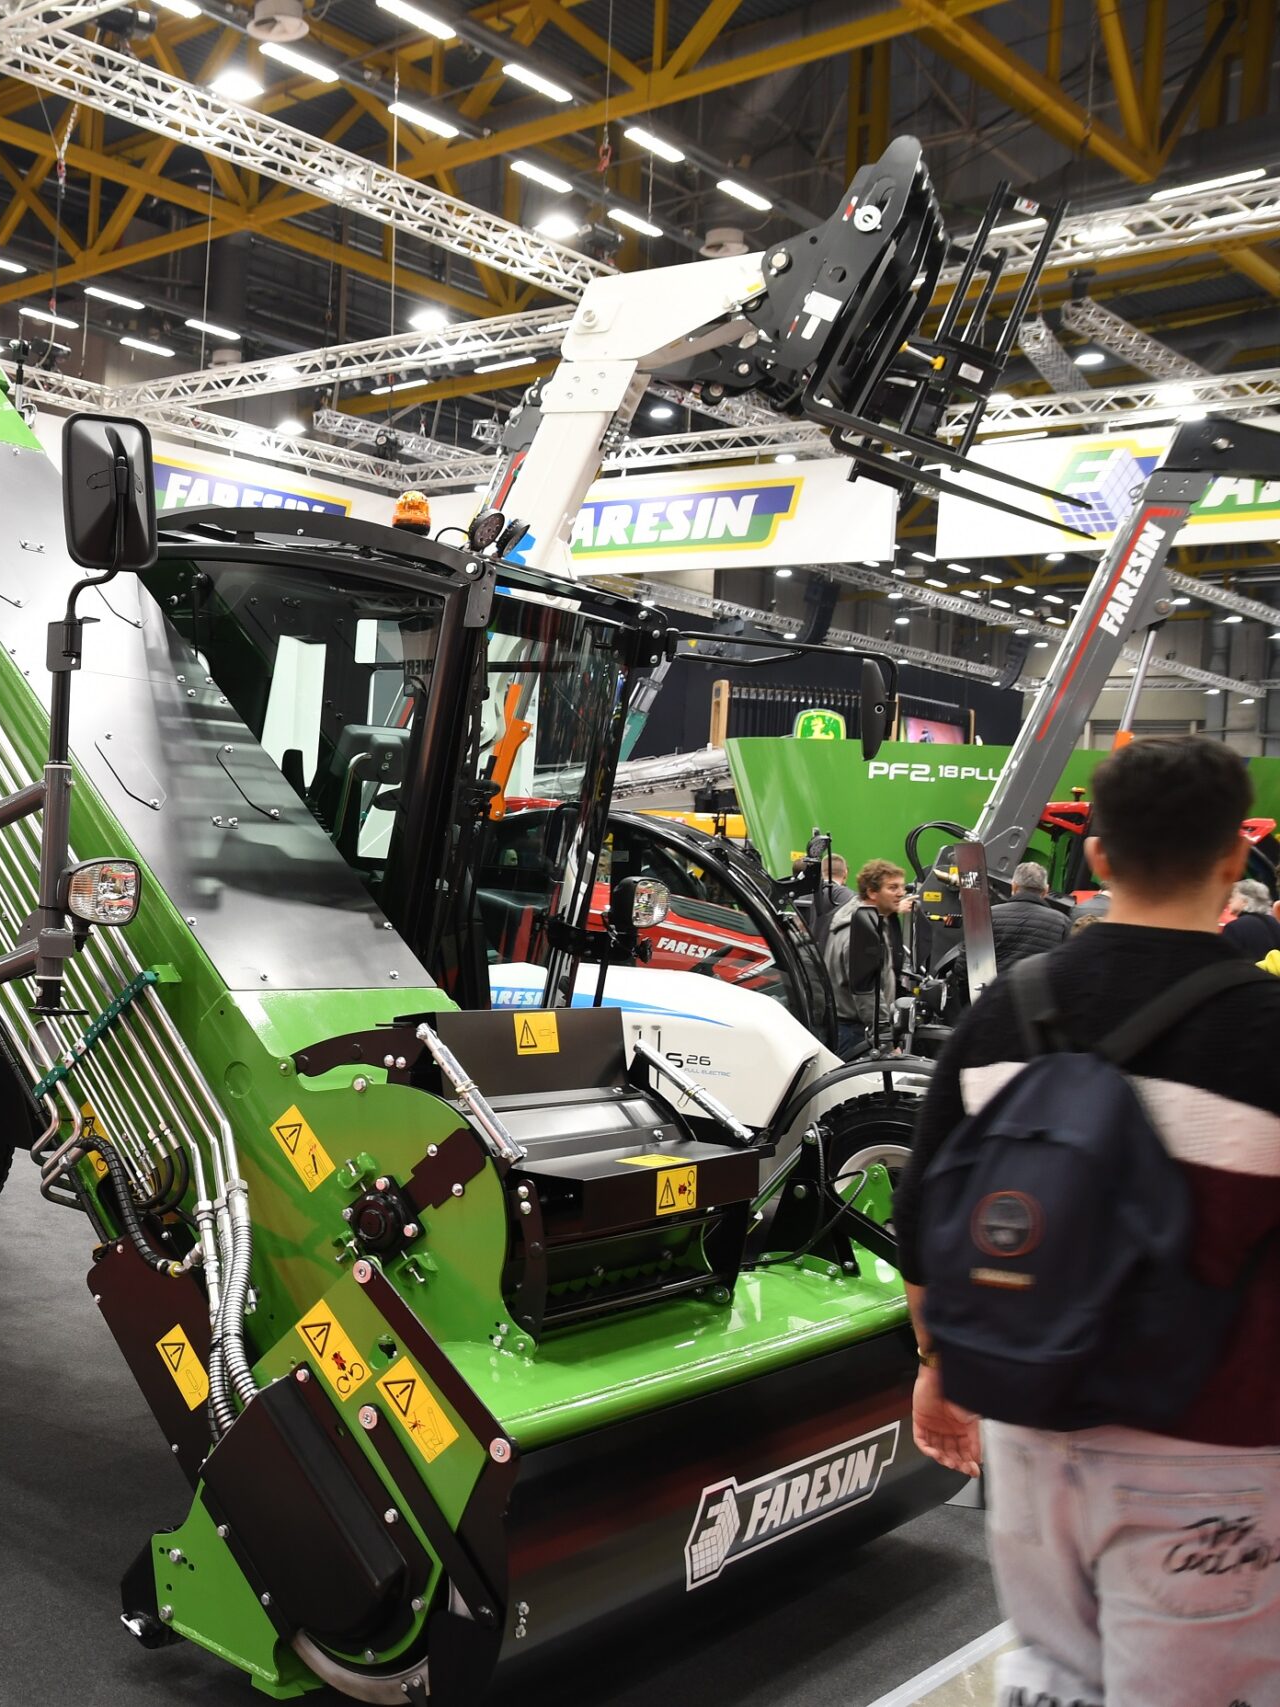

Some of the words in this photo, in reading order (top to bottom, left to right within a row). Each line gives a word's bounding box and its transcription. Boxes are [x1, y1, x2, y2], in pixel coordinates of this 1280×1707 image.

[570, 494, 760, 548] ARESIN
[1098, 519, 1167, 638] FARESIN
[960, 766, 1006, 782] PLU
[656, 936, 718, 959] FARESI
[683, 1067, 700, 1075] FULL
[701, 1069, 732, 1078] ELECTRIC
[741, 1443, 879, 1543] FARESIN
